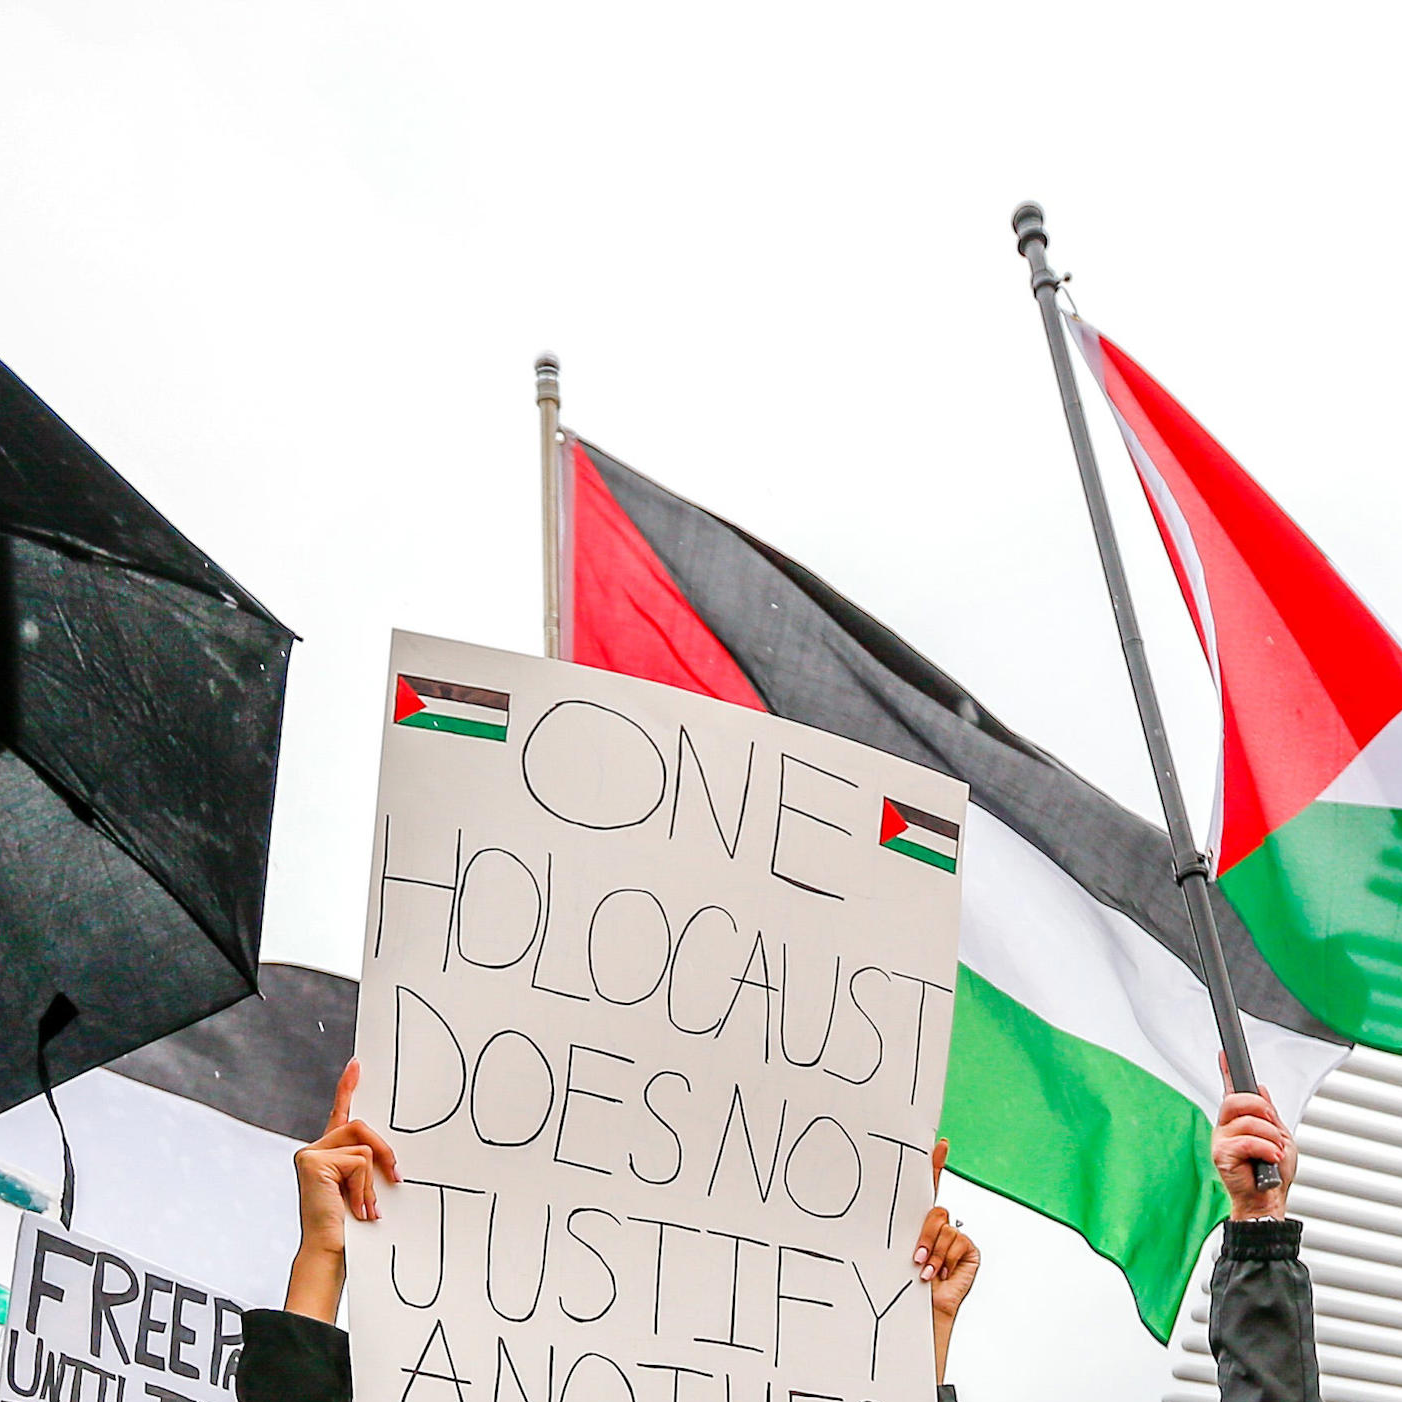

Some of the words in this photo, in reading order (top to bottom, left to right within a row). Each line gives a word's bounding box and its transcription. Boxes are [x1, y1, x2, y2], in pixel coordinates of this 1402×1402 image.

[521, 698, 859, 901] ONE
[374, 812, 953, 1106] HOLOCAUST
[390, 985, 692, 1187] DOES
[707, 1083, 928, 1250] NOT
[26, 1228, 200, 1381] FREE
[390, 1178, 913, 1382] JUSTIFY
